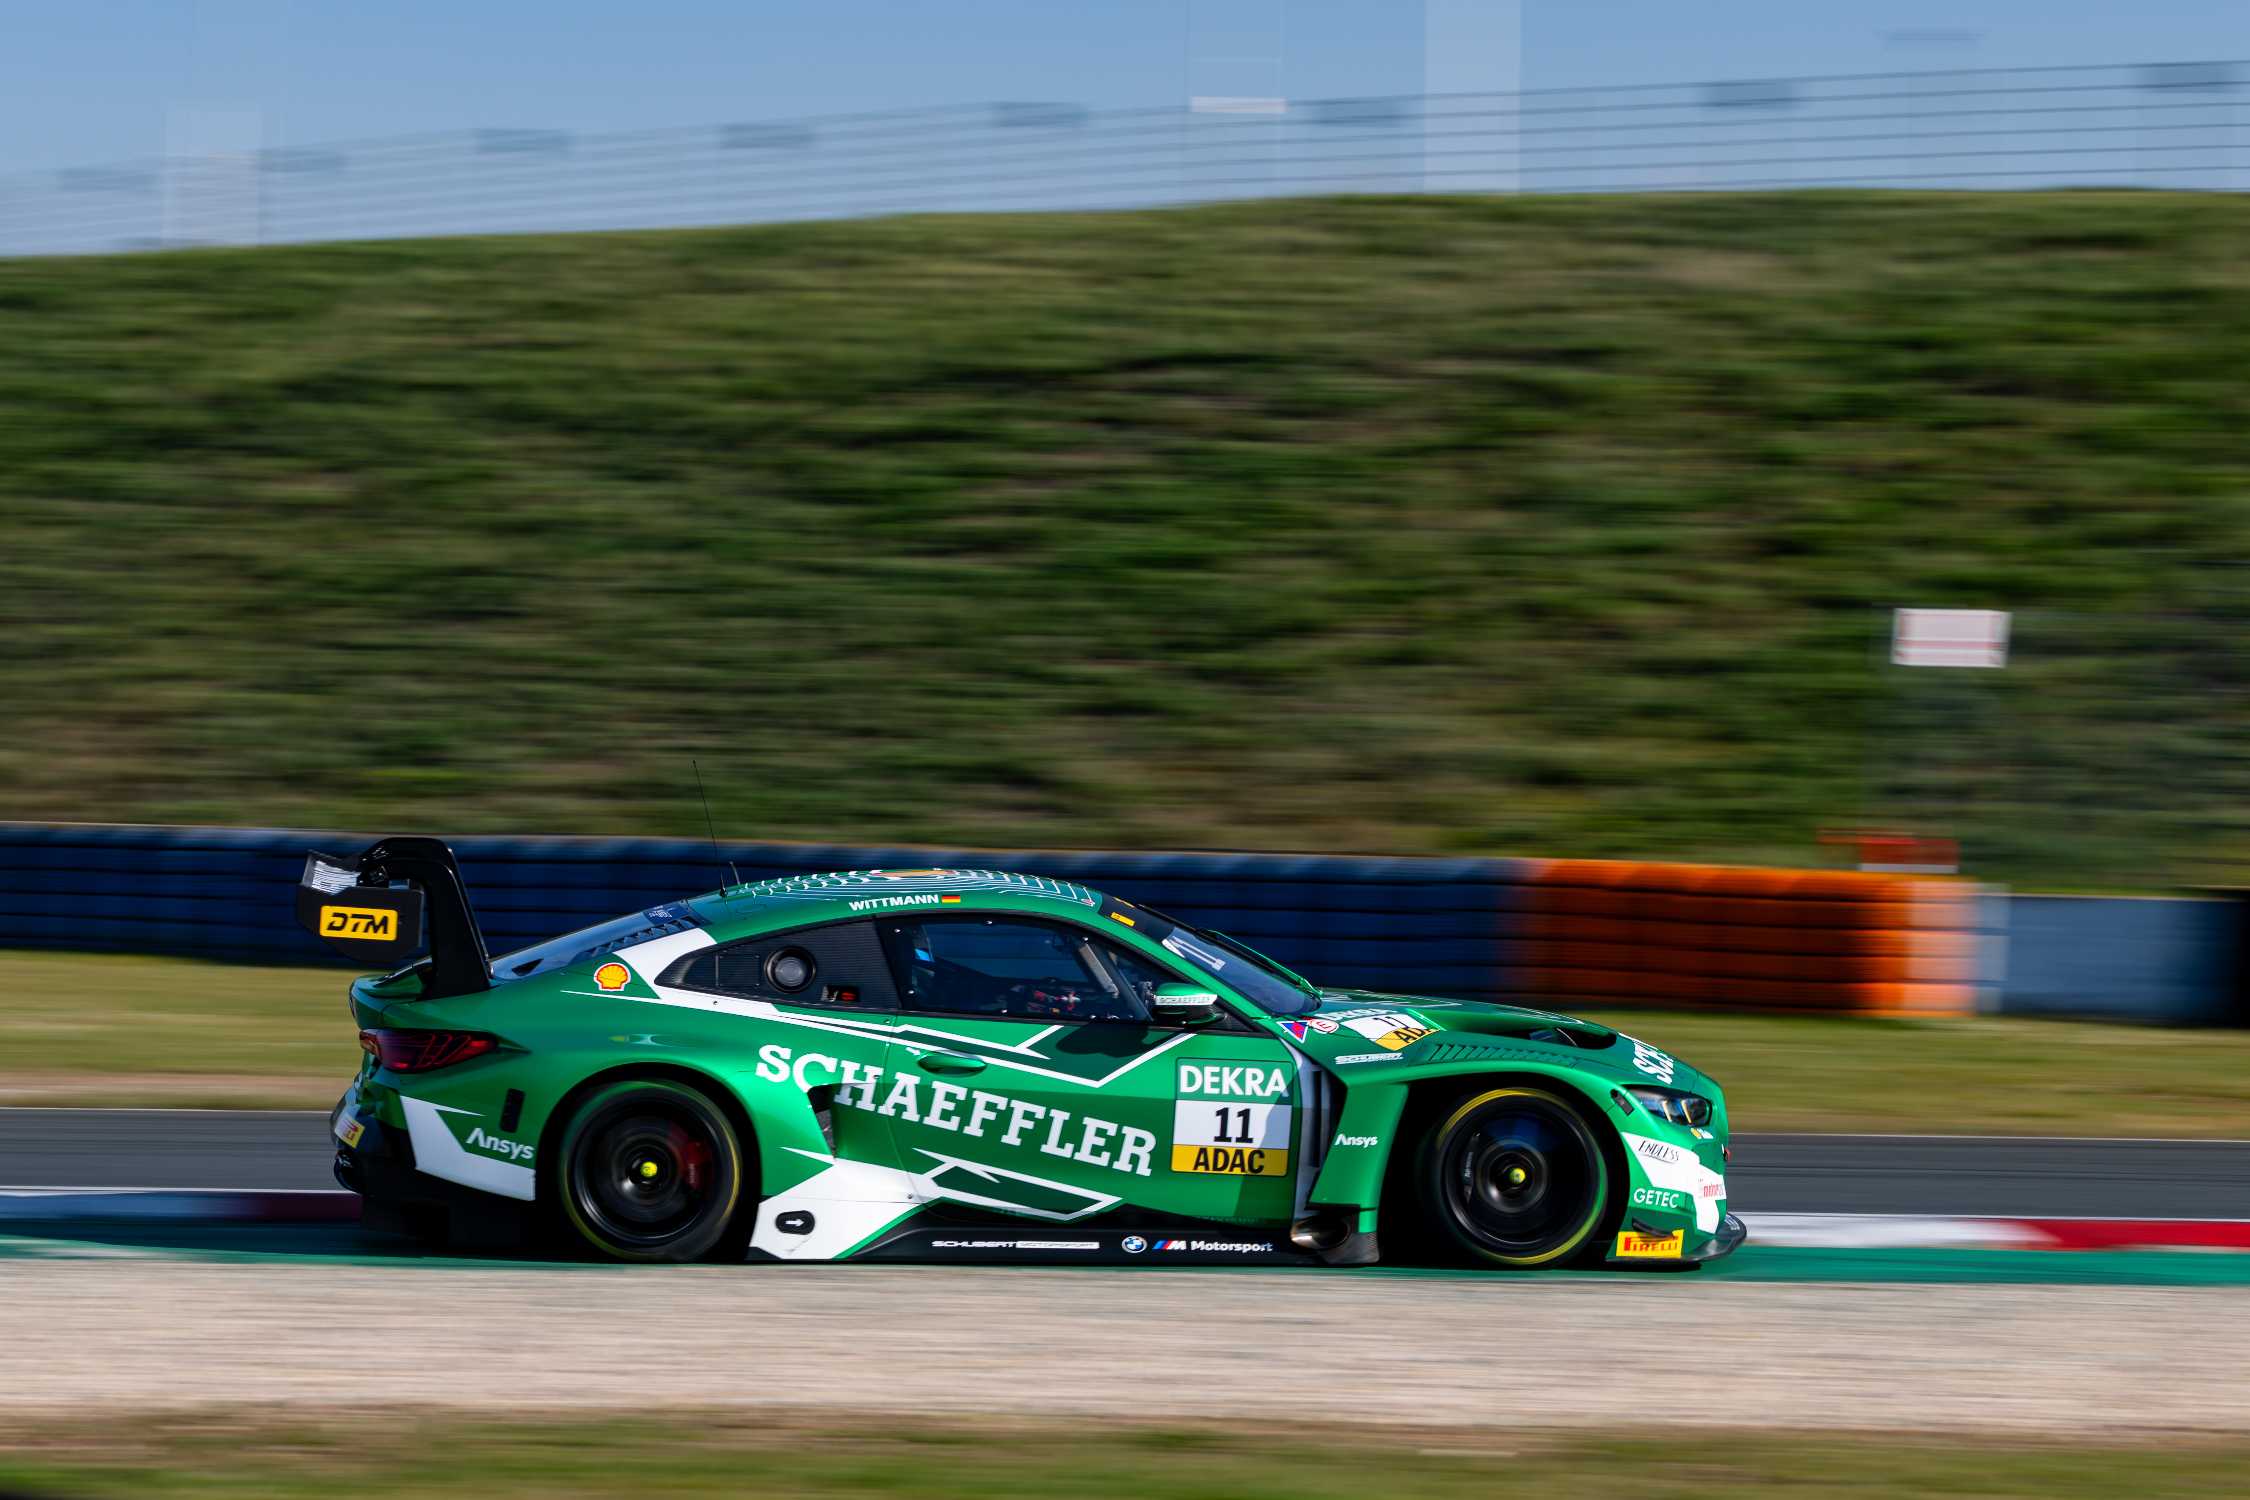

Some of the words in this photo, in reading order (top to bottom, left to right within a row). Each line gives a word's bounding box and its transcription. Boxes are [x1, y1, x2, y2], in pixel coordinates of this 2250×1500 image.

[848, 893, 939, 911] WITTMANN
[327, 911, 389, 935] DTM
[1393, 1025, 1434, 1044] AD
[1179, 1064, 1290, 1098] DEKRA
[755, 1044, 1157, 1177] SCHAEFFLER
[1213, 1106, 1254, 1144] 11
[465, 1127, 536, 1160] Ansys
[1333, 1133, 1379, 1149] Ansys
[1192, 1147, 1265, 1174] ADAC
[1633, 1187, 1680, 1209] GETEC
[931, 1240, 1016, 1248] SCHUBERT
[1190, 1240, 1273, 1253] Motorsport
[1623, 1235, 1679, 1252] PIRELLI
